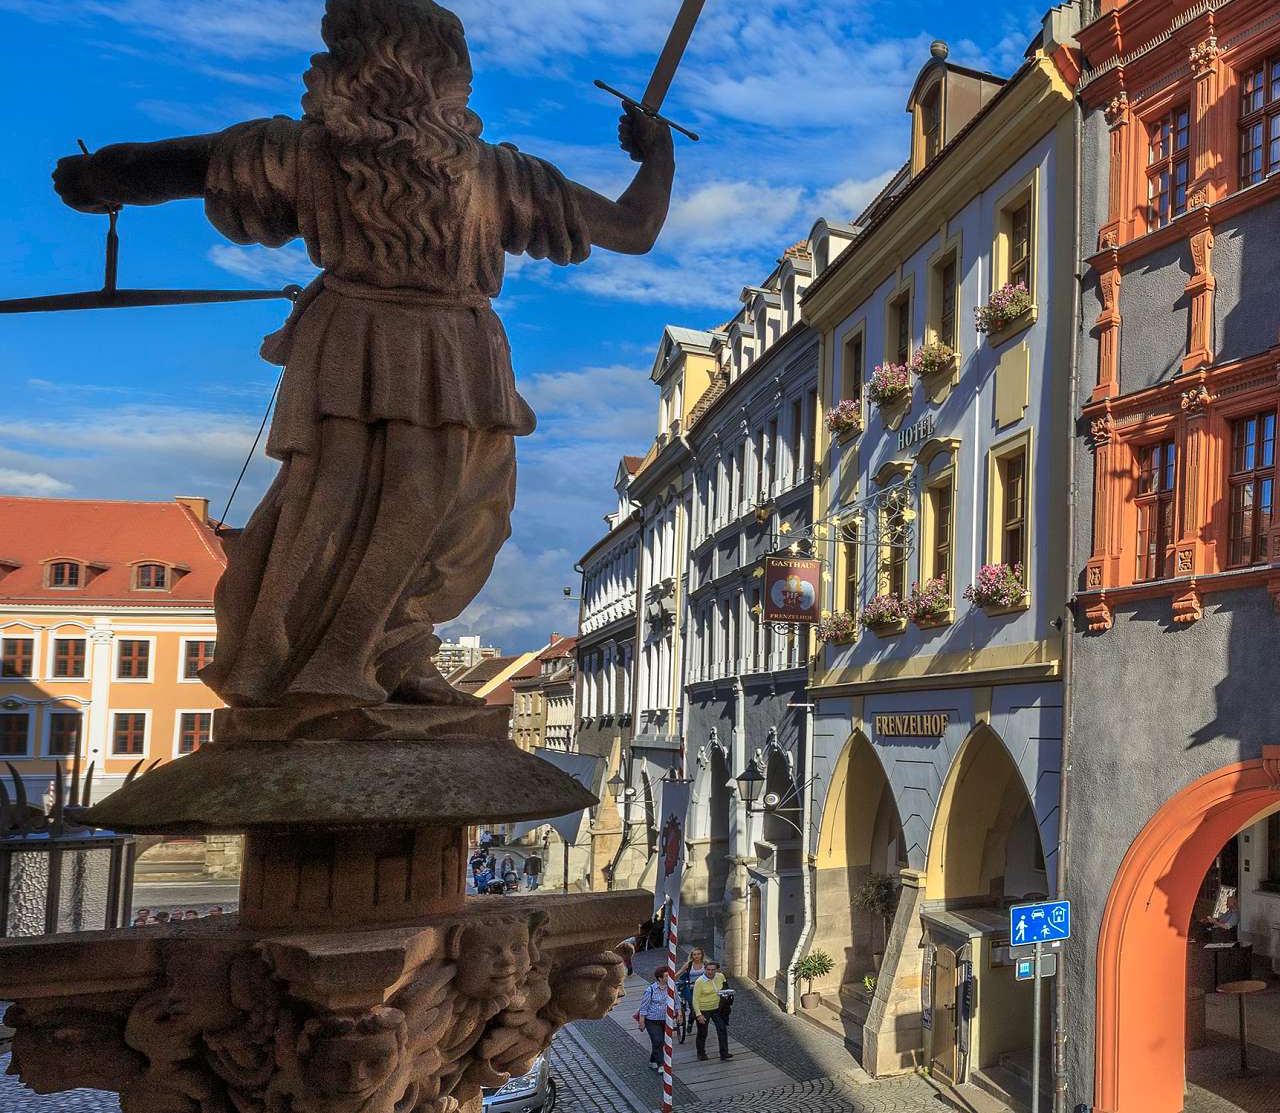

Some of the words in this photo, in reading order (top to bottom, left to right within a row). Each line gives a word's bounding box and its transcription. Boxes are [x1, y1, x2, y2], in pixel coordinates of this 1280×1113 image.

[896, 414, 934, 451] HOTEL
[771, 560, 816, 569] GASTHAUS
[875, 713, 949, 736] FRENZELHOF
